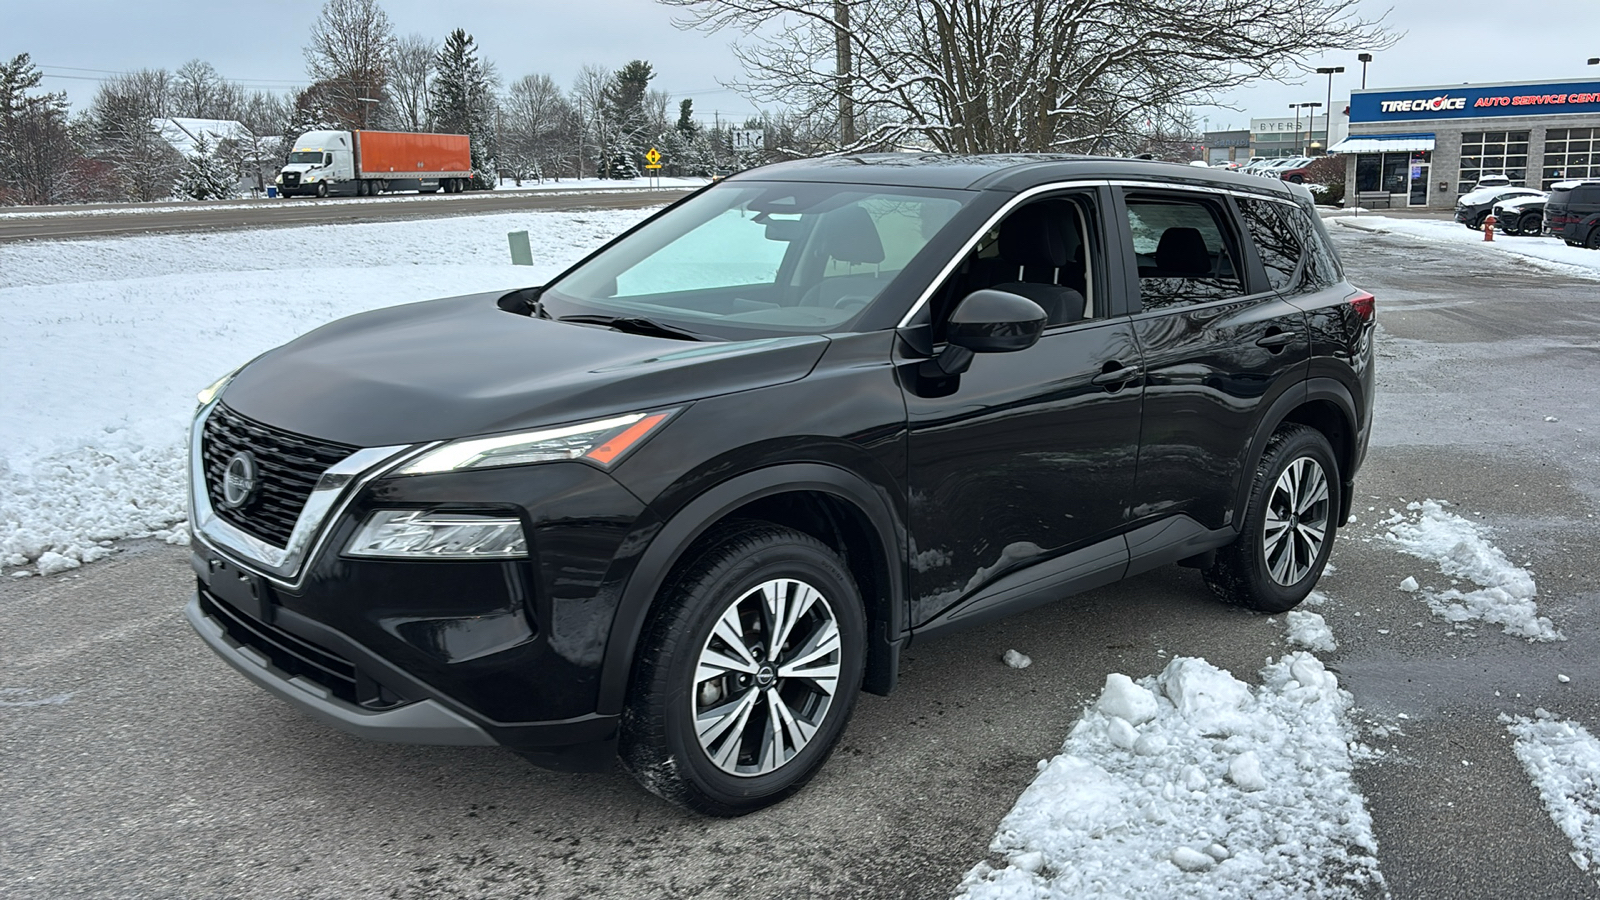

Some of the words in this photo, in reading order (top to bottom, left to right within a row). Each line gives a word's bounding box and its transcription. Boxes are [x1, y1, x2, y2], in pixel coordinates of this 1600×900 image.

[1474, 97, 1510, 107] AUTO
[1511, 94, 1567, 106] SERVICE
[1260, 121, 1303, 131] BYERS
